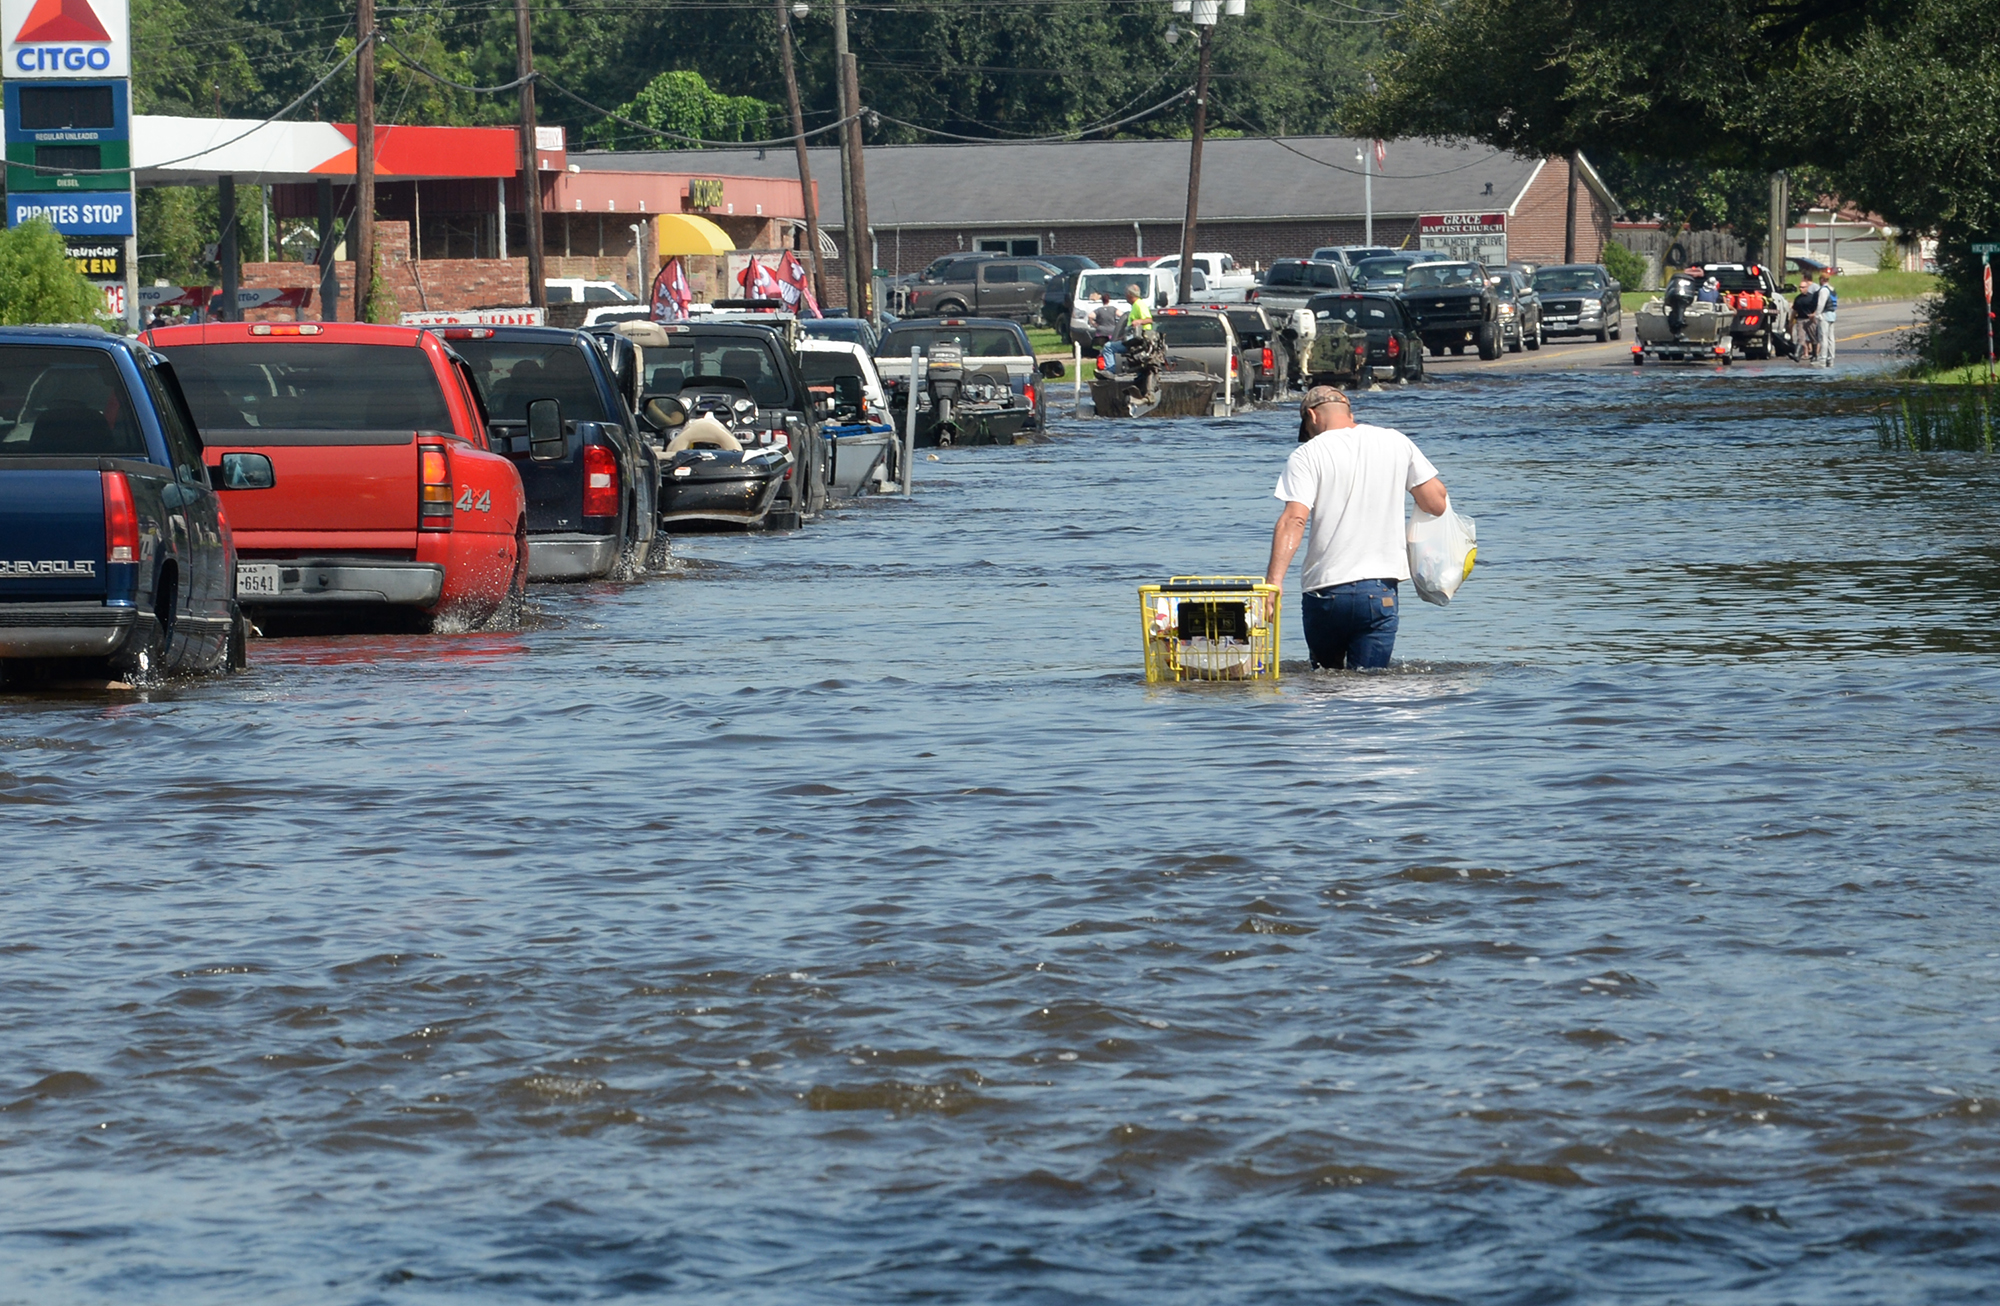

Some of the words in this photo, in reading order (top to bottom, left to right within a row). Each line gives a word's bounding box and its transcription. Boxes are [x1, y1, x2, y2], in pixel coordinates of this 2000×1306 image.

[16, 47, 111, 71] CITGO
[35, 132, 64, 141] REGULAR
[65, 132, 99, 140] UNLEADED
[57, 178, 79, 187] DIESEL
[16, 205, 79, 224] PIRATES
[82, 204, 123, 224] STOP
[1443, 215, 1482, 225] GRACE
[1422, 225, 1461, 233] BAPTIST
[1462, 224, 1503, 232] CHURCH
[1426, 239, 1435, 248] TO
[1439, 237, 1474, 247] "ALMOST"
[1476, 237, 1502, 246] BELIEVE
[1461, 247, 1470, 256] TO
[0, 560, 95, 574] CHEVROLET
[245, 576, 274, 591] 6541
